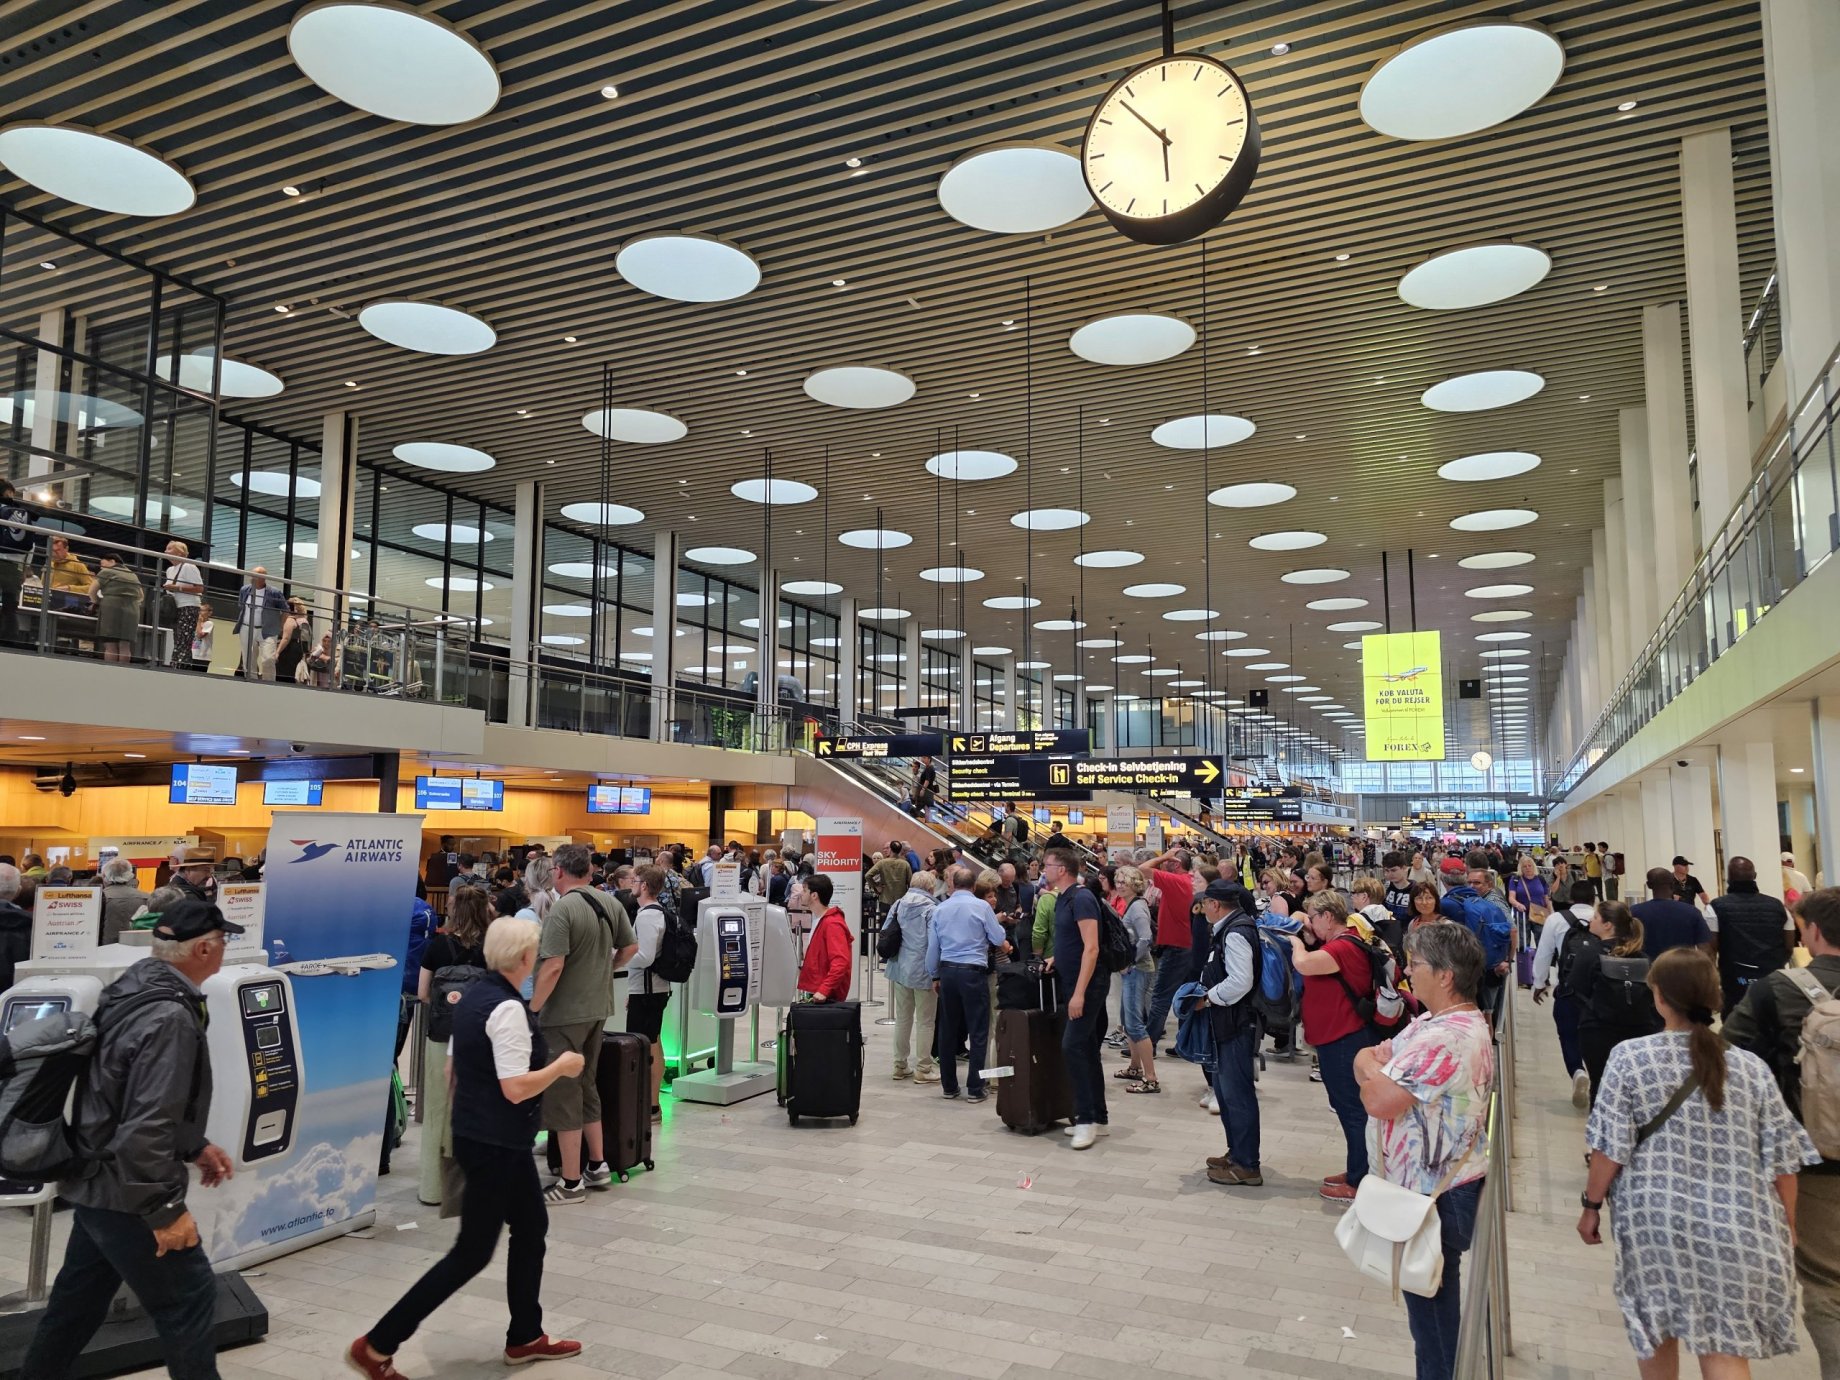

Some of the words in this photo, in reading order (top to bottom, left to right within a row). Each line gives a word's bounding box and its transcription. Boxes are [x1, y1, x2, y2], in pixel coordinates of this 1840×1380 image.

[989, 734, 1016, 743] Afgang
[862, 742, 888, 750] Express
[989, 743, 1030, 752] Departures
[1076, 762, 1118, 772] Check-in
[1120, 761, 1186, 773] Selvbetjening
[1076, 774, 1095, 784] Self
[1097, 774, 1133, 784] Service
[1135, 773, 1179, 783] Check-in
[346, 840, 403, 849] ATLANTIC
[345, 852, 402, 862] AIRWAYS
[261, 1208, 335, 1237] www.atlantic.fo
